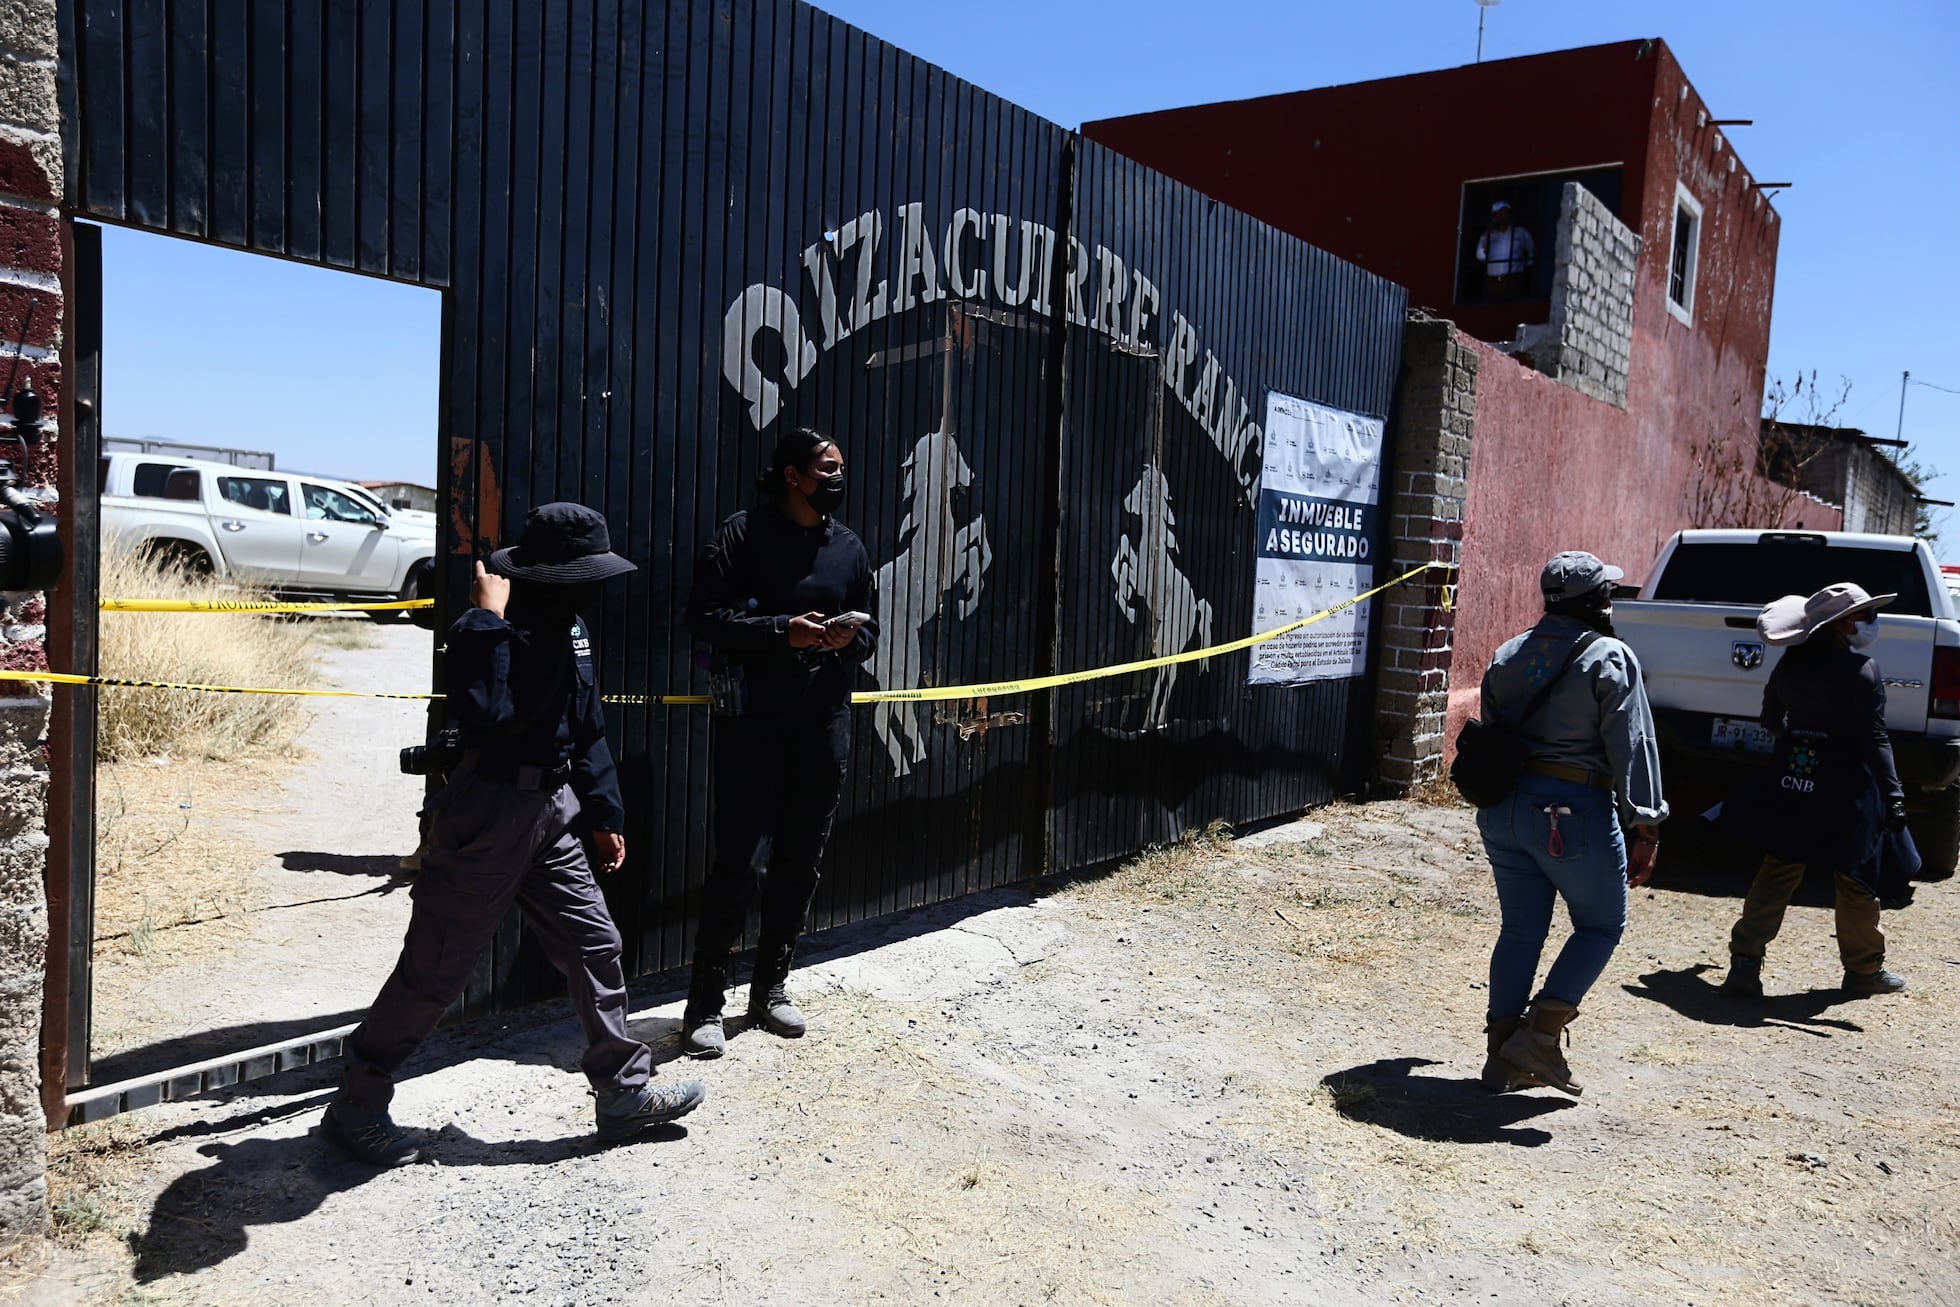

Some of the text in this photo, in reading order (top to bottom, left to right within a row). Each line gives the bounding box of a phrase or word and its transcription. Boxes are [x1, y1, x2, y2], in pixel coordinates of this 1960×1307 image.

[1278, 498, 1363, 531] INMUEBLE
[1265, 527, 1369, 559] ASEGURADO
[572, 638, 590, 650] CNB
[1781, 775, 1815, 793] CNB
